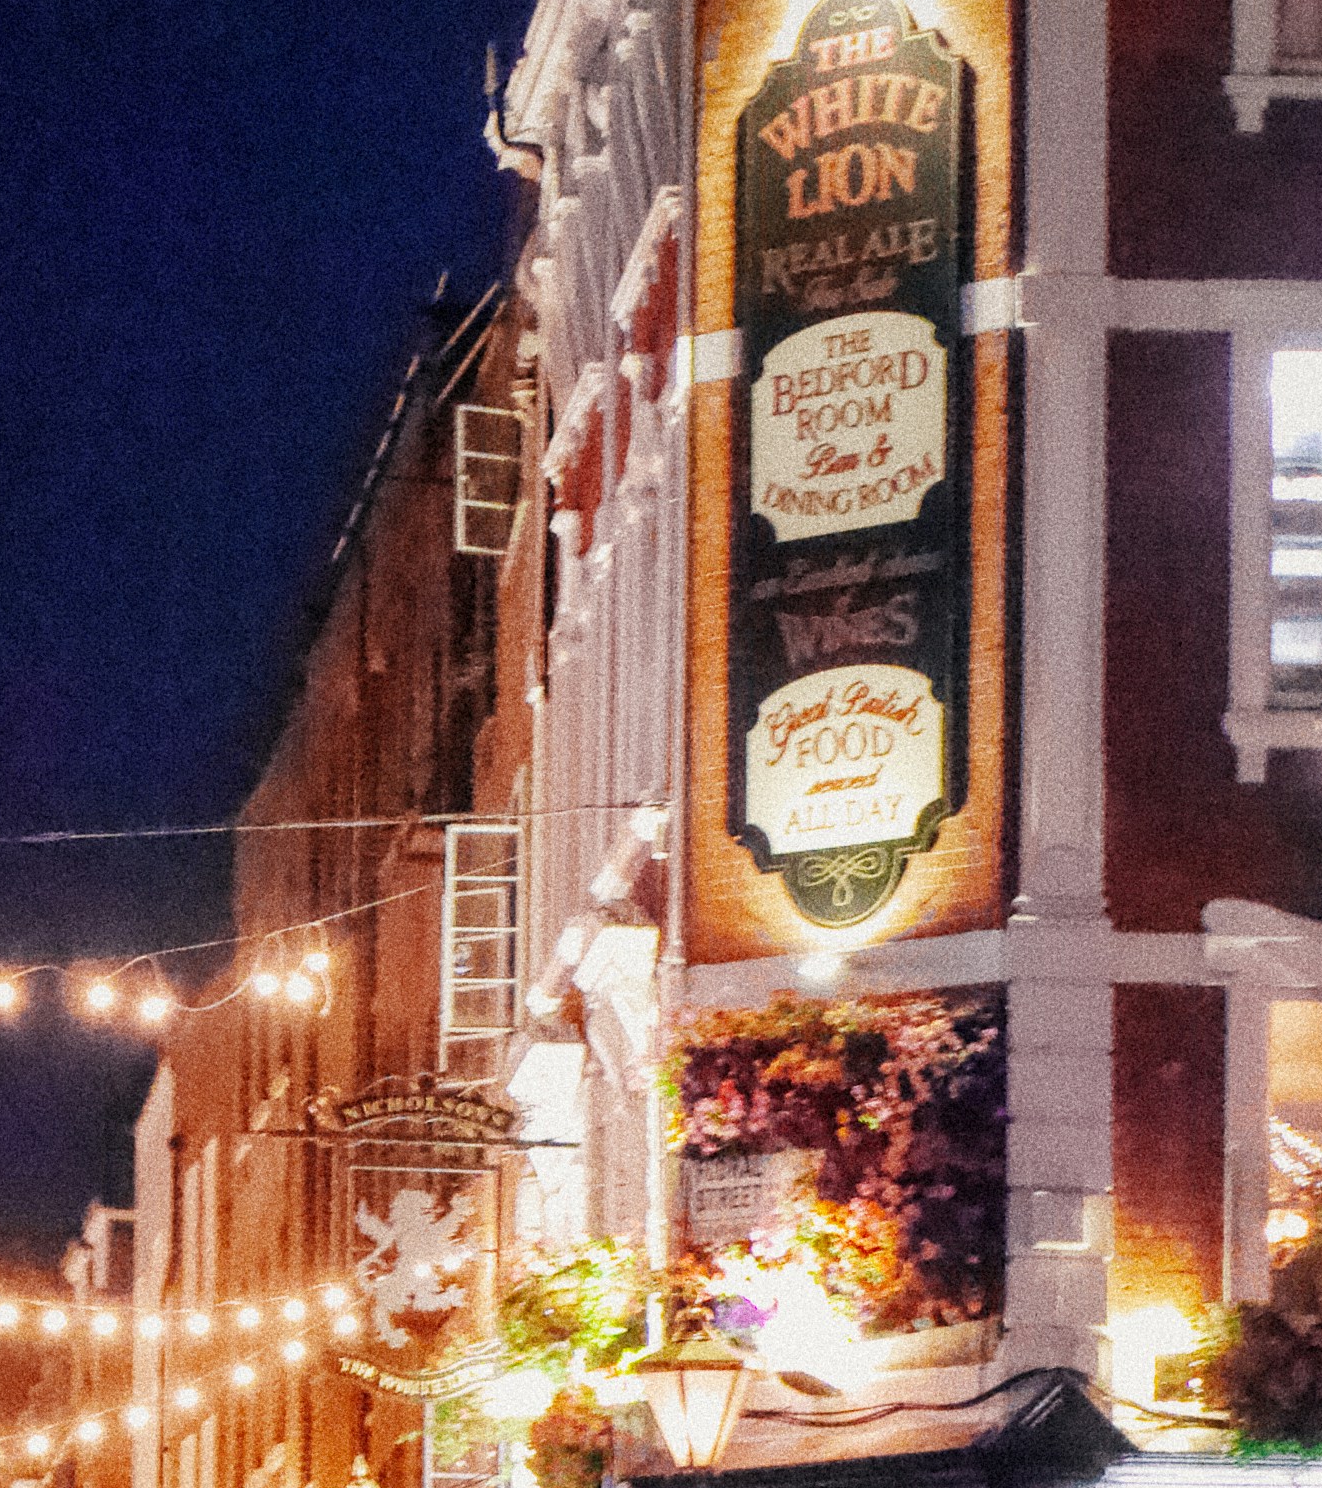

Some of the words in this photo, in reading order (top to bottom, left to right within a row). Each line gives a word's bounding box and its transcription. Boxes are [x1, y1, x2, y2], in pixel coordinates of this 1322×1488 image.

[809, 25, 899, 73] THE
[757, 72, 949, 160] WHITE
[785, 142, 919, 220] LION
[822, 328, 873, 359] THE
[771, 349, 929, 417] BEDFORD
[796, 392, 892, 442] ROOM
[761, 482, 853, 517] DINING
[857, 451, 937, 510] ROOM
[795, 721, 895, 769] FOOD
[784, 803, 835, 836] ALL
[845, 792, 903, 826] DAY
